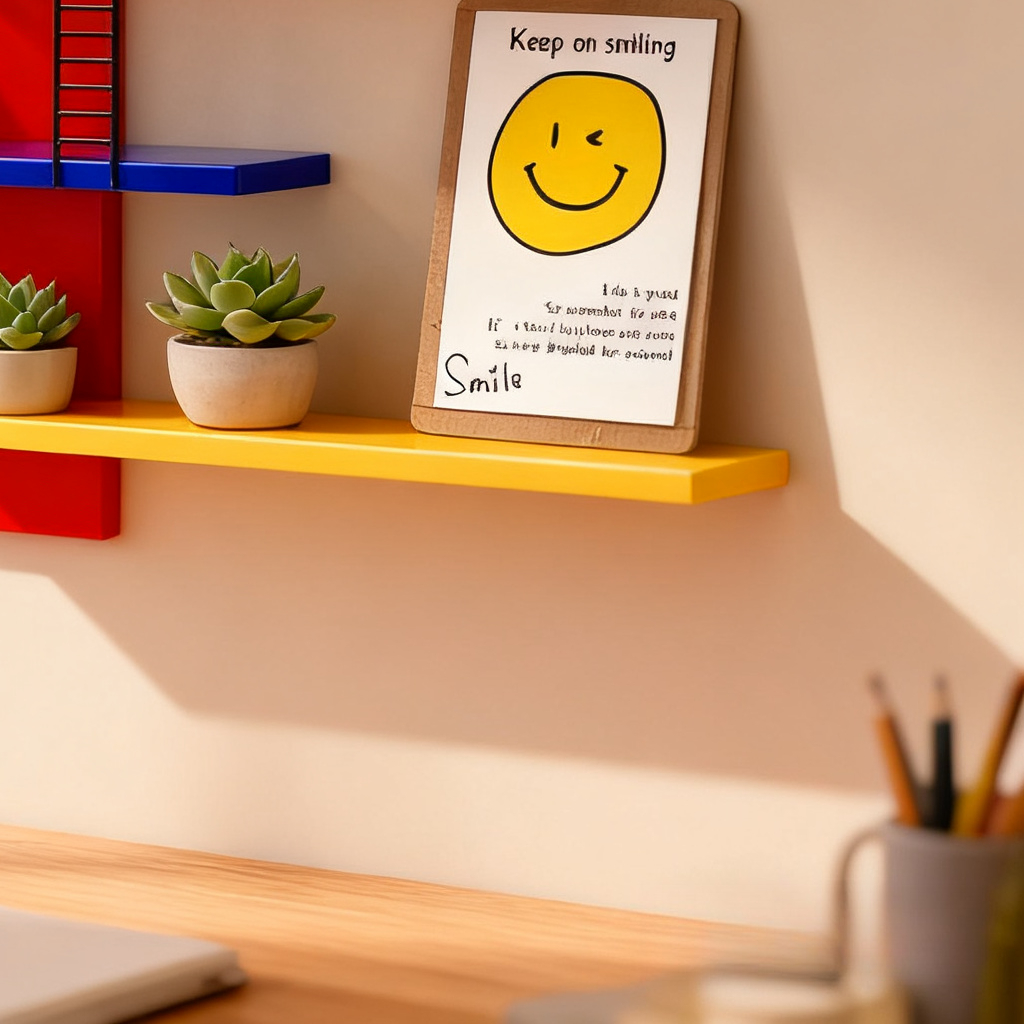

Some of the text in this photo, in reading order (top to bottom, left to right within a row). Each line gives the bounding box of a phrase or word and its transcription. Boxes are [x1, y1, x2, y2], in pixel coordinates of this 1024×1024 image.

[509, 26, 676, 63] Keep on smiling
[444, 353, 522, 396] Smile
